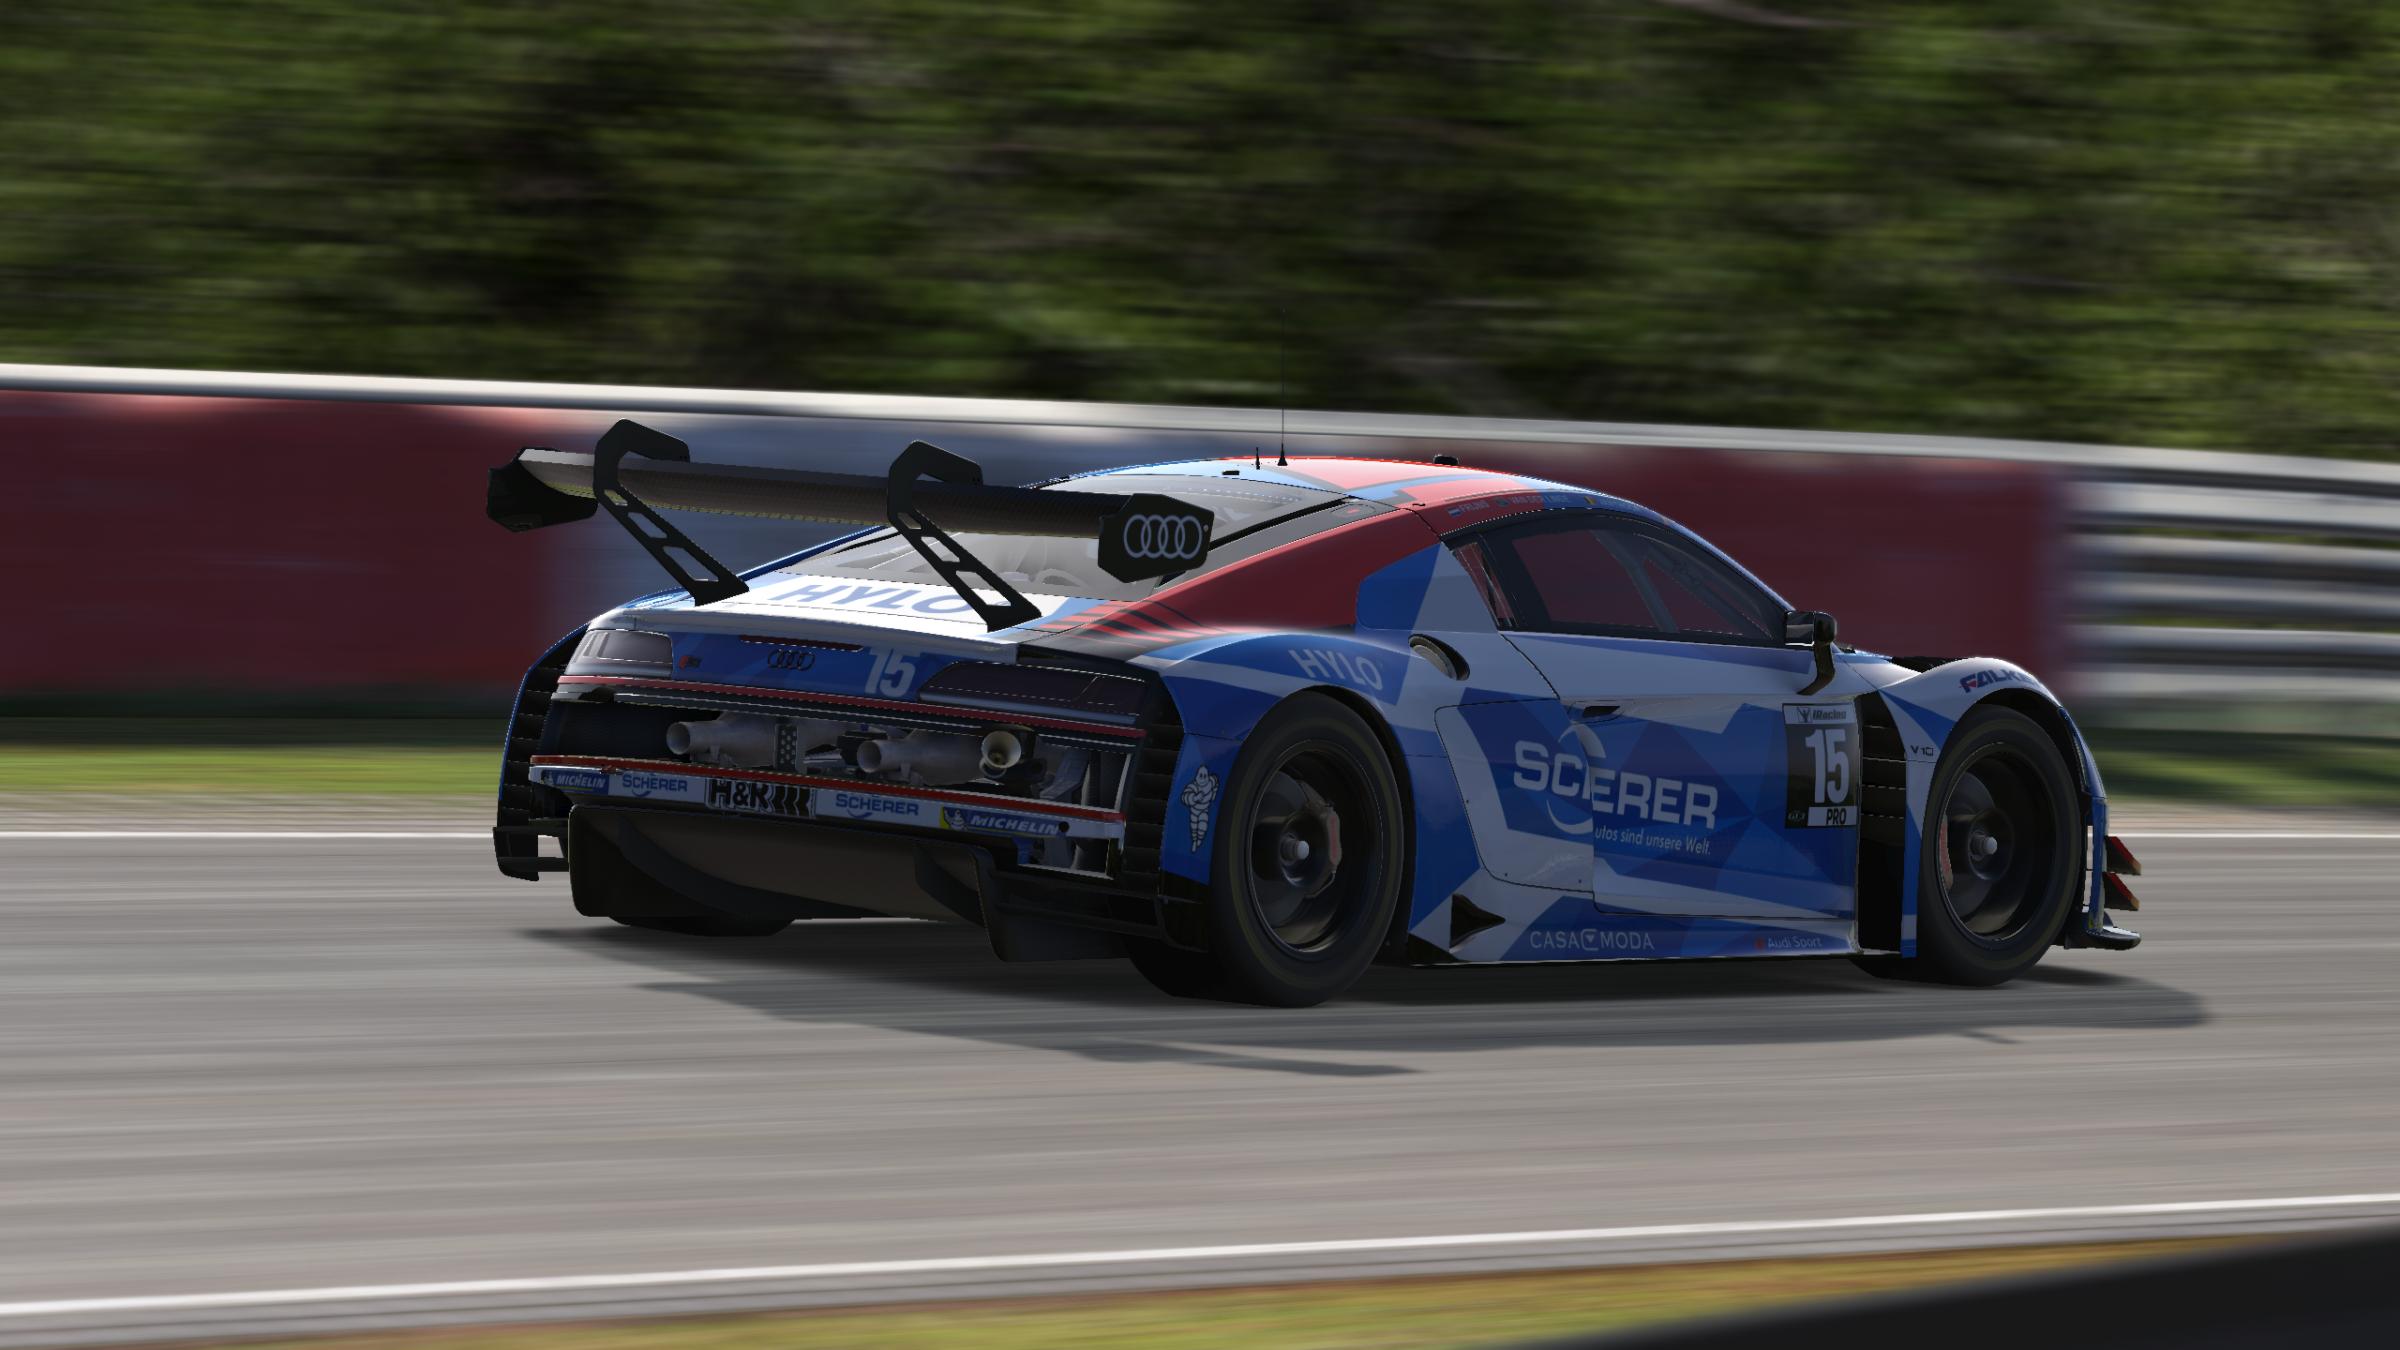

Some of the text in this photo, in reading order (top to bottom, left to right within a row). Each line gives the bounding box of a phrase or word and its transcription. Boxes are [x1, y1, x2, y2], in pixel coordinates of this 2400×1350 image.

[768, 584, 971, 614] HYLO
[864, 647, 920, 698] 15
[1288, 649, 1384, 691] HYLO
[1805, 728, 1849, 804] 15
[556, 774, 608, 789] MICHELIN
[622, 773, 688, 793] SCHERER
[835, 792, 919, 816] SCHERER
[1826, 808, 1847, 825] PRO
[970, 814, 1058, 835] MICHELIN
[1594, 825, 1618, 842] utos
[1619, 828, 1644, 846] sind
[1645, 835, 1683, 851] unsere
